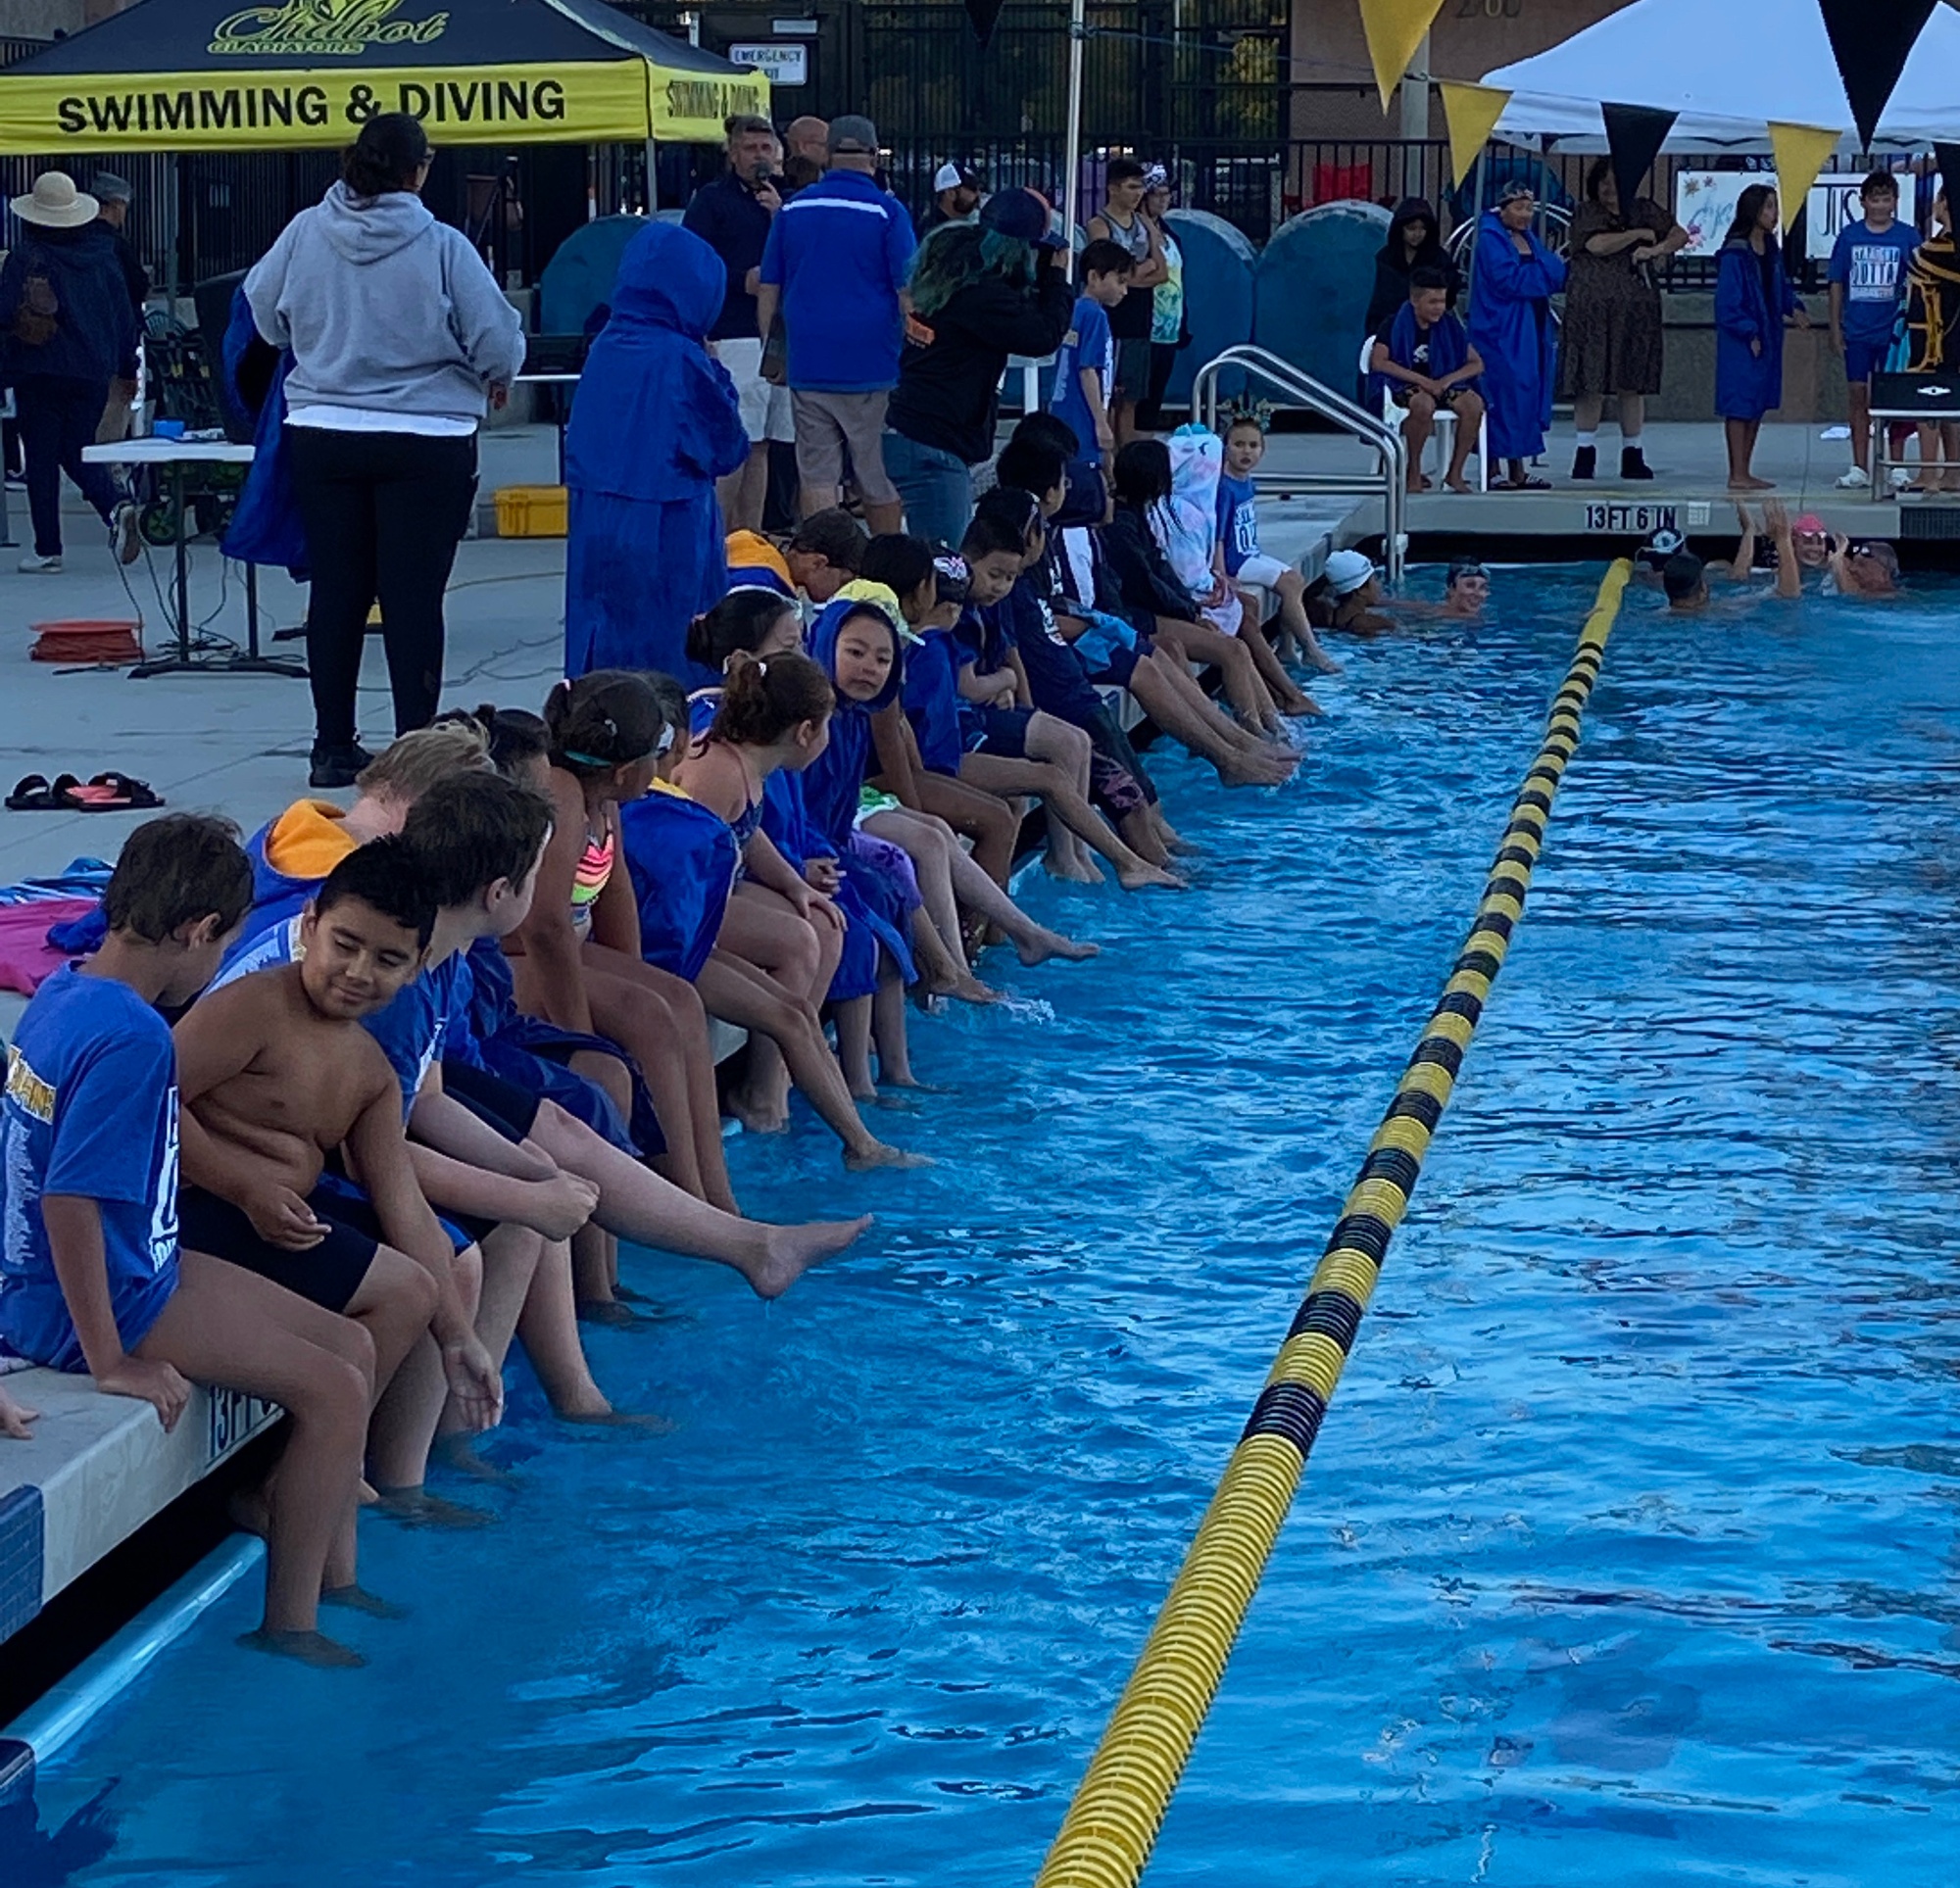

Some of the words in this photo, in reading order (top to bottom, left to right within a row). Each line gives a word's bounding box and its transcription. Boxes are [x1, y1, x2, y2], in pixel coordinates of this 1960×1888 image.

[734, 49, 803, 64] EMERGENCY
[58, 87, 329, 133] SWIMMING
[345, 84, 382, 124] &
[398, 79, 565, 122] DIVING
[1636, 505, 1650, 530] 6
[1655, 506, 1676, 530] IN
